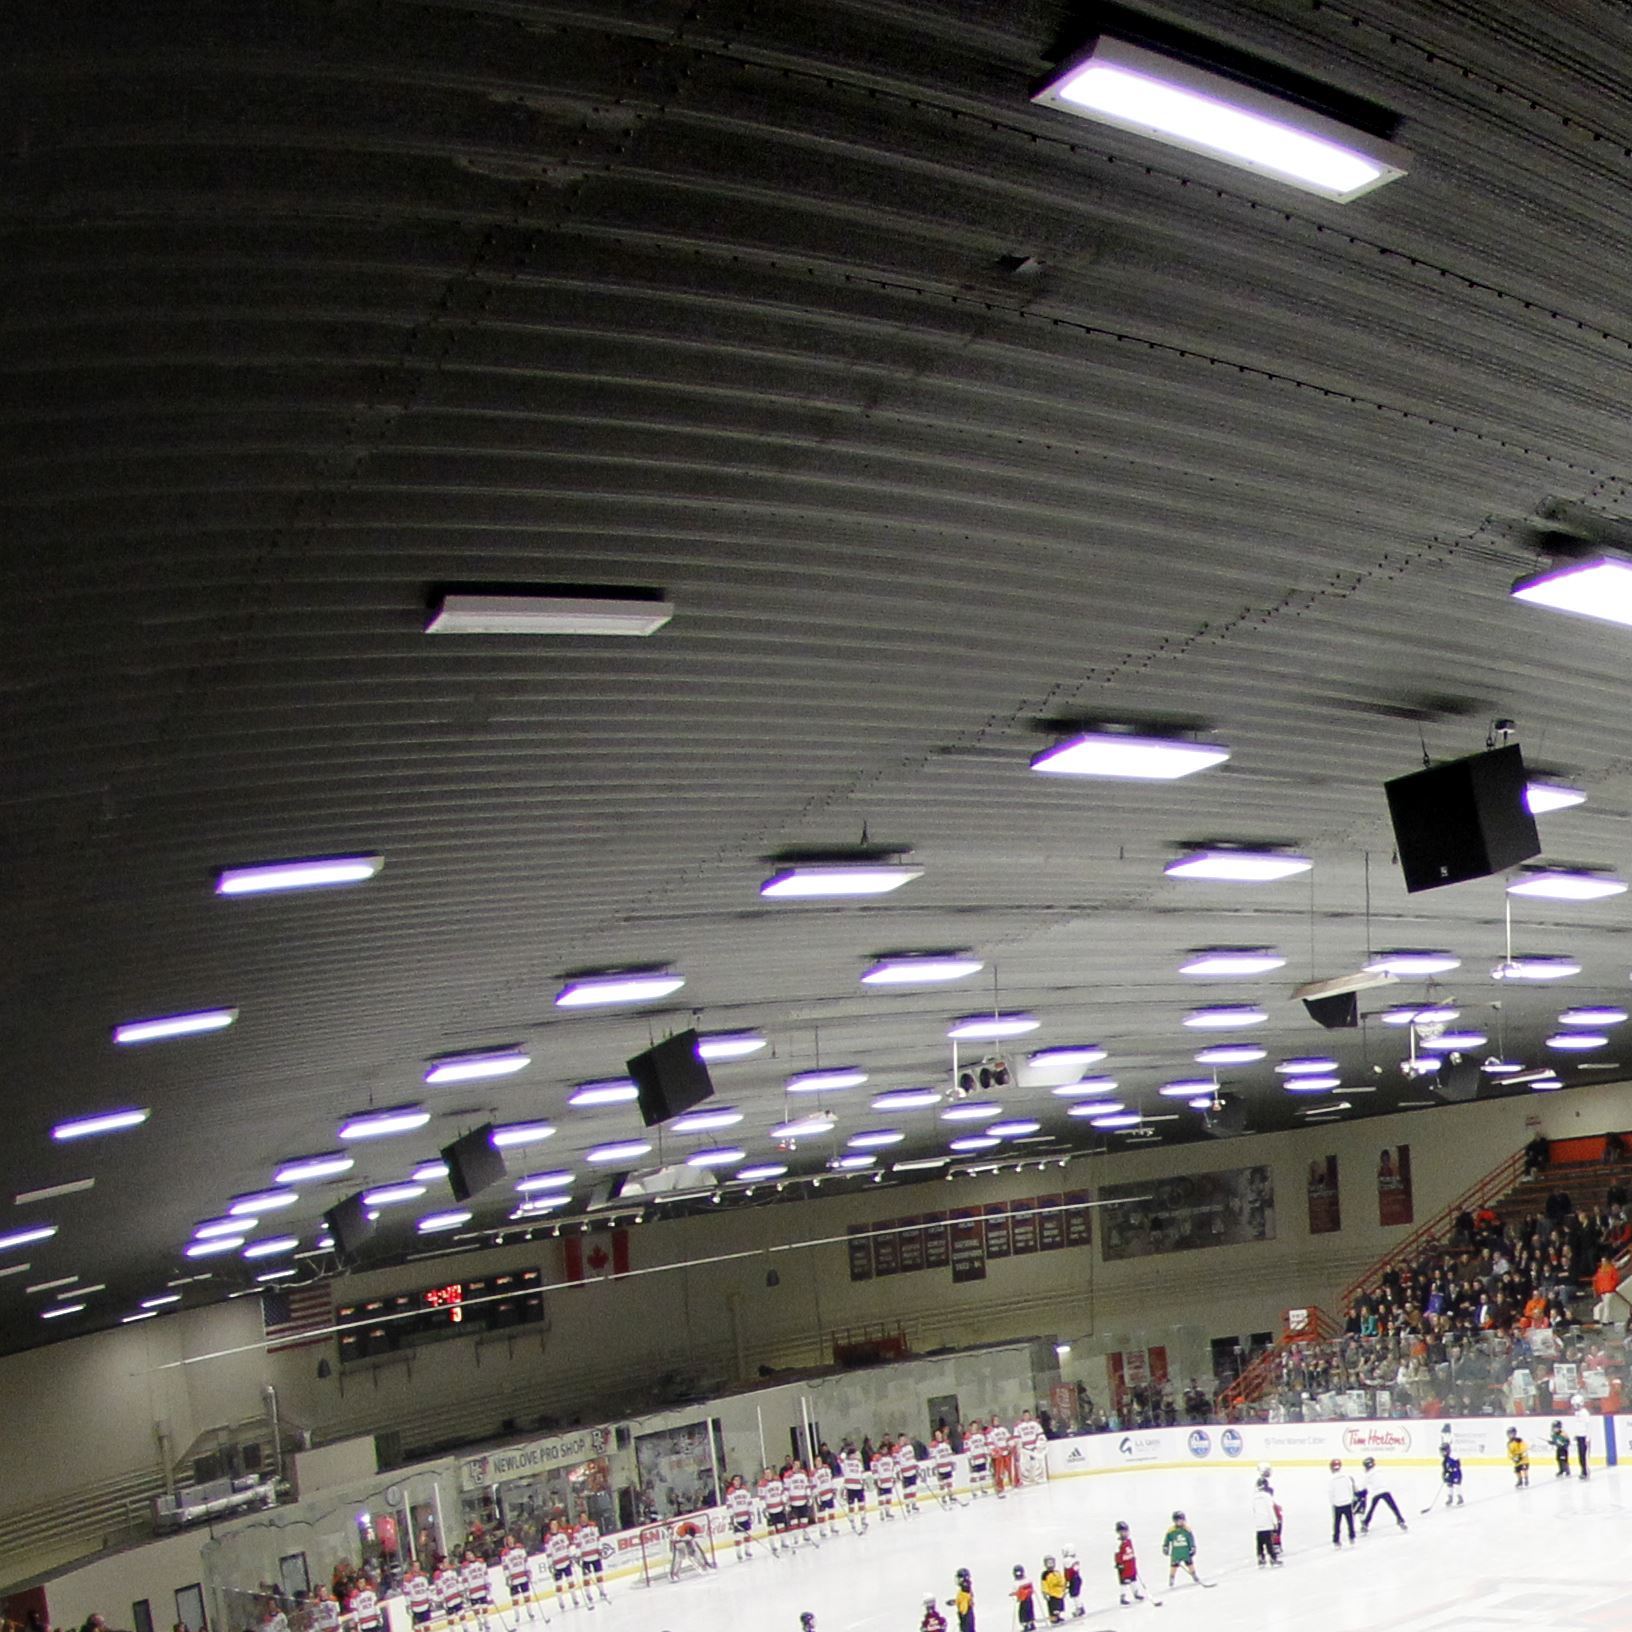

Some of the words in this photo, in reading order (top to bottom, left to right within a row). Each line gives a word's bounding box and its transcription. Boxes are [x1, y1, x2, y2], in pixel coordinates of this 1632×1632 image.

[1348, 1429, 1366, 1446] Tim
[1368, 1429, 1406, 1446] Hortons
[493, 1452, 538, 1473] NEWLOVE
[540, 1444, 560, 1461] PRO
[561, 1438, 586, 1457] SHOP
